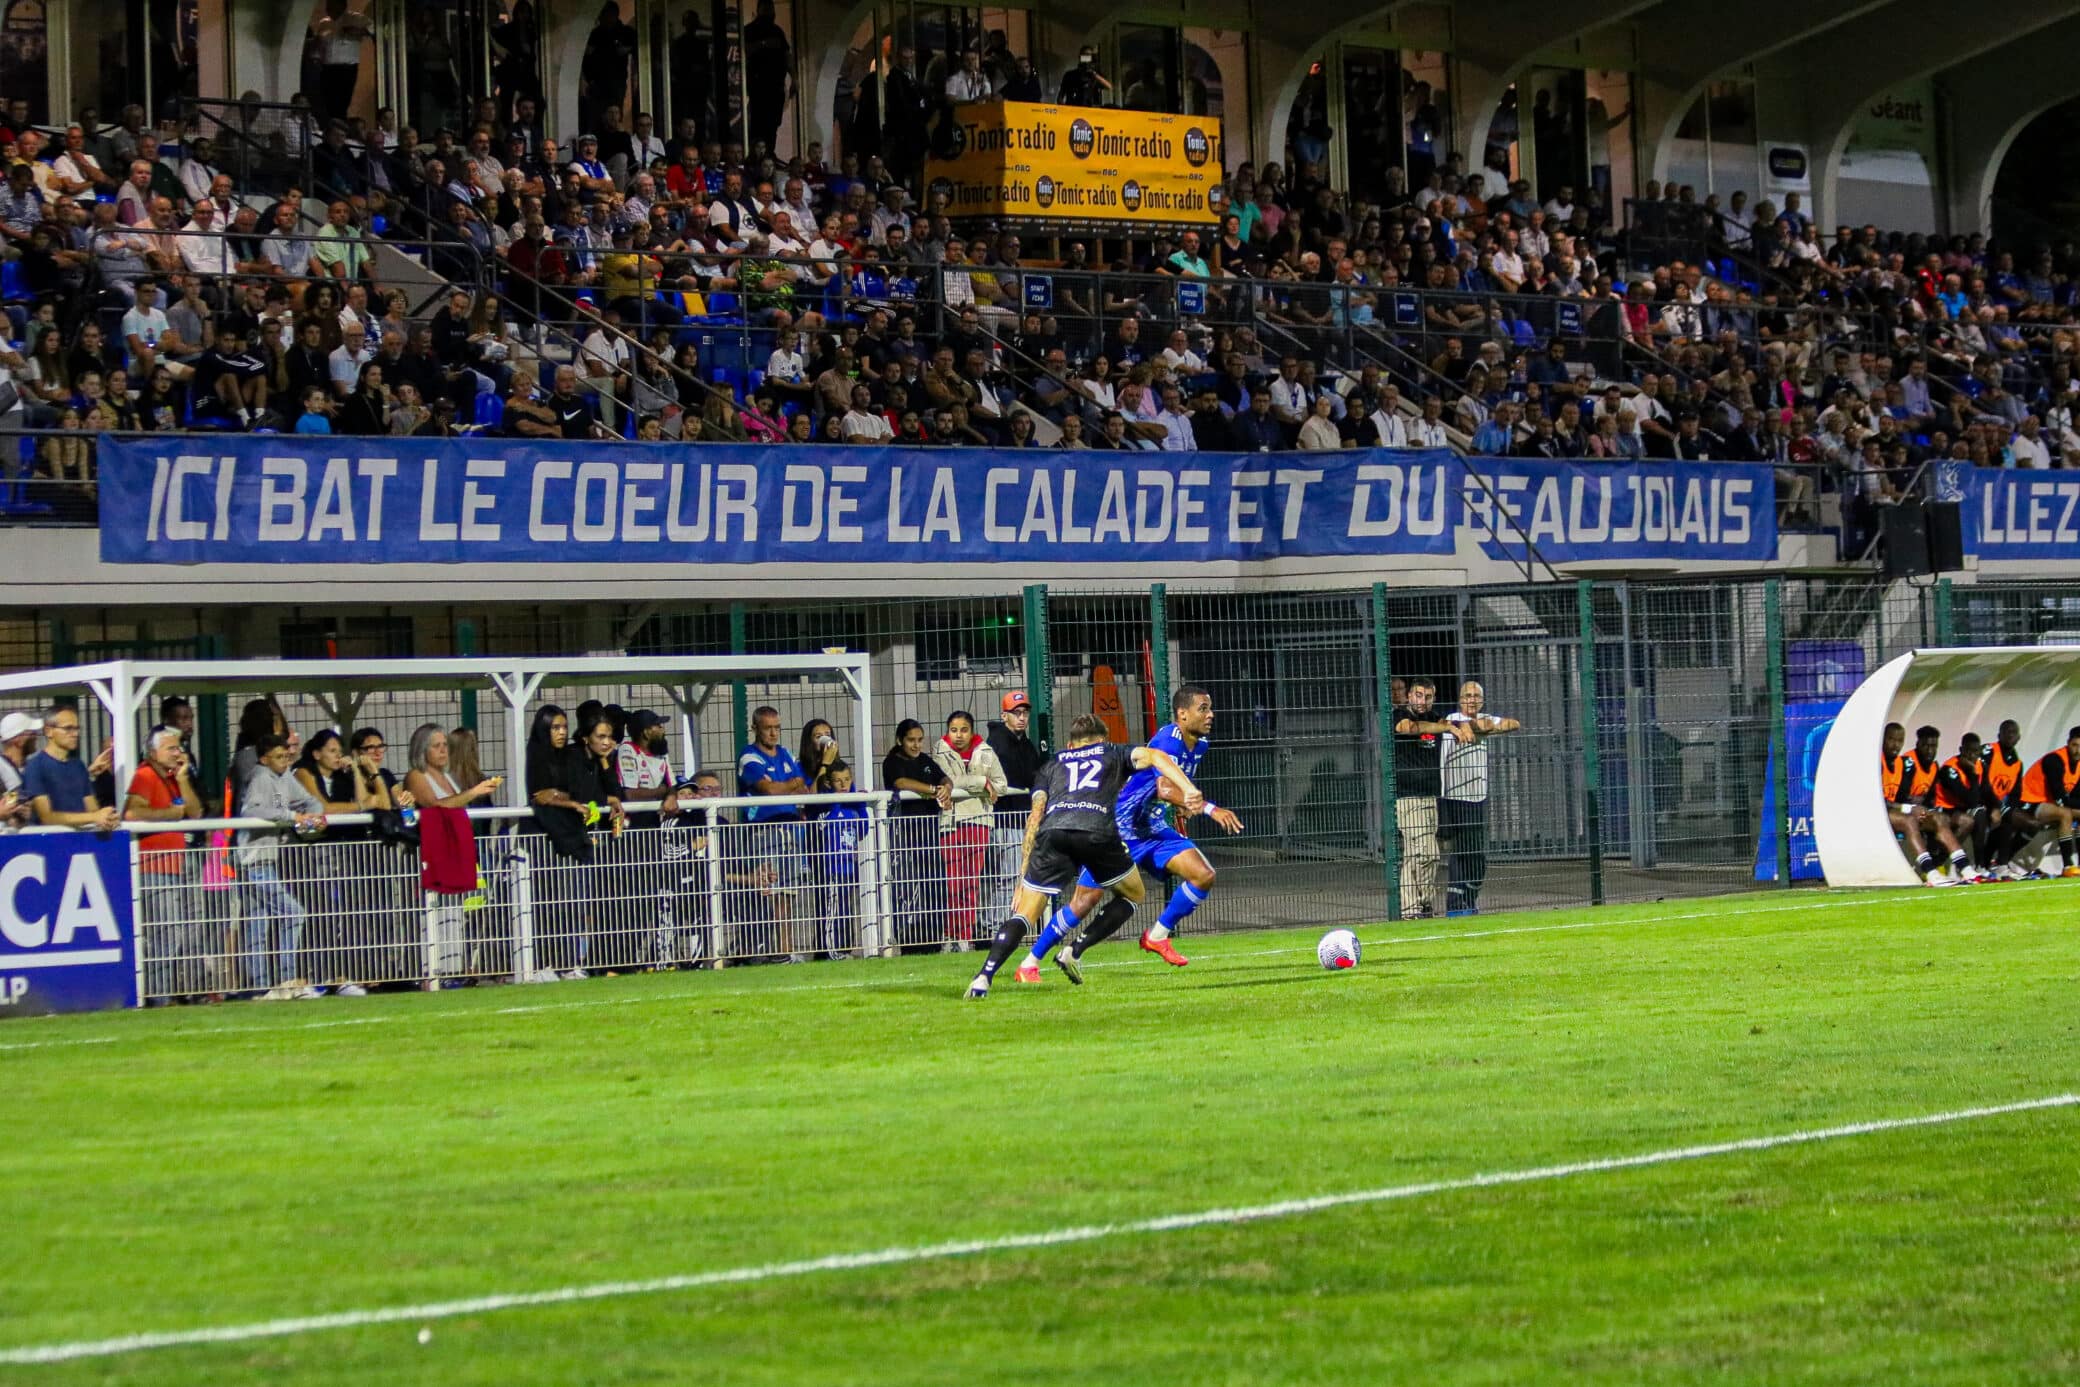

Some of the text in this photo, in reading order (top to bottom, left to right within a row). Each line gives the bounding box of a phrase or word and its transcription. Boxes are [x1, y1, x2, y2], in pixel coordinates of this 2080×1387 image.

[965, 122, 1014, 152] Tonic
[1017, 122, 1055, 150] radio
[1073, 125, 1092, 142] Tonic
[1094, 126, 1171, 159] Tonic radio
[1186, 134, 1206, 150] Tonic
[955, 180, 1030, 206] Tonic radio
[1055, 181, 1117, 206] Tonic radio
[1141, 185, 1170, 209] Tonic
[1173, 187, 1203, 210] radio
[146, 456, 1751, 544] ICI BAT LE COEUR DE LA CALADE ET DU BEAUJOLAIS
[1976, 482, 2080, 543] LLEZ
[1065, 760, 1102, 792] 12
[1057, 801, 1107, 814] Groupama
